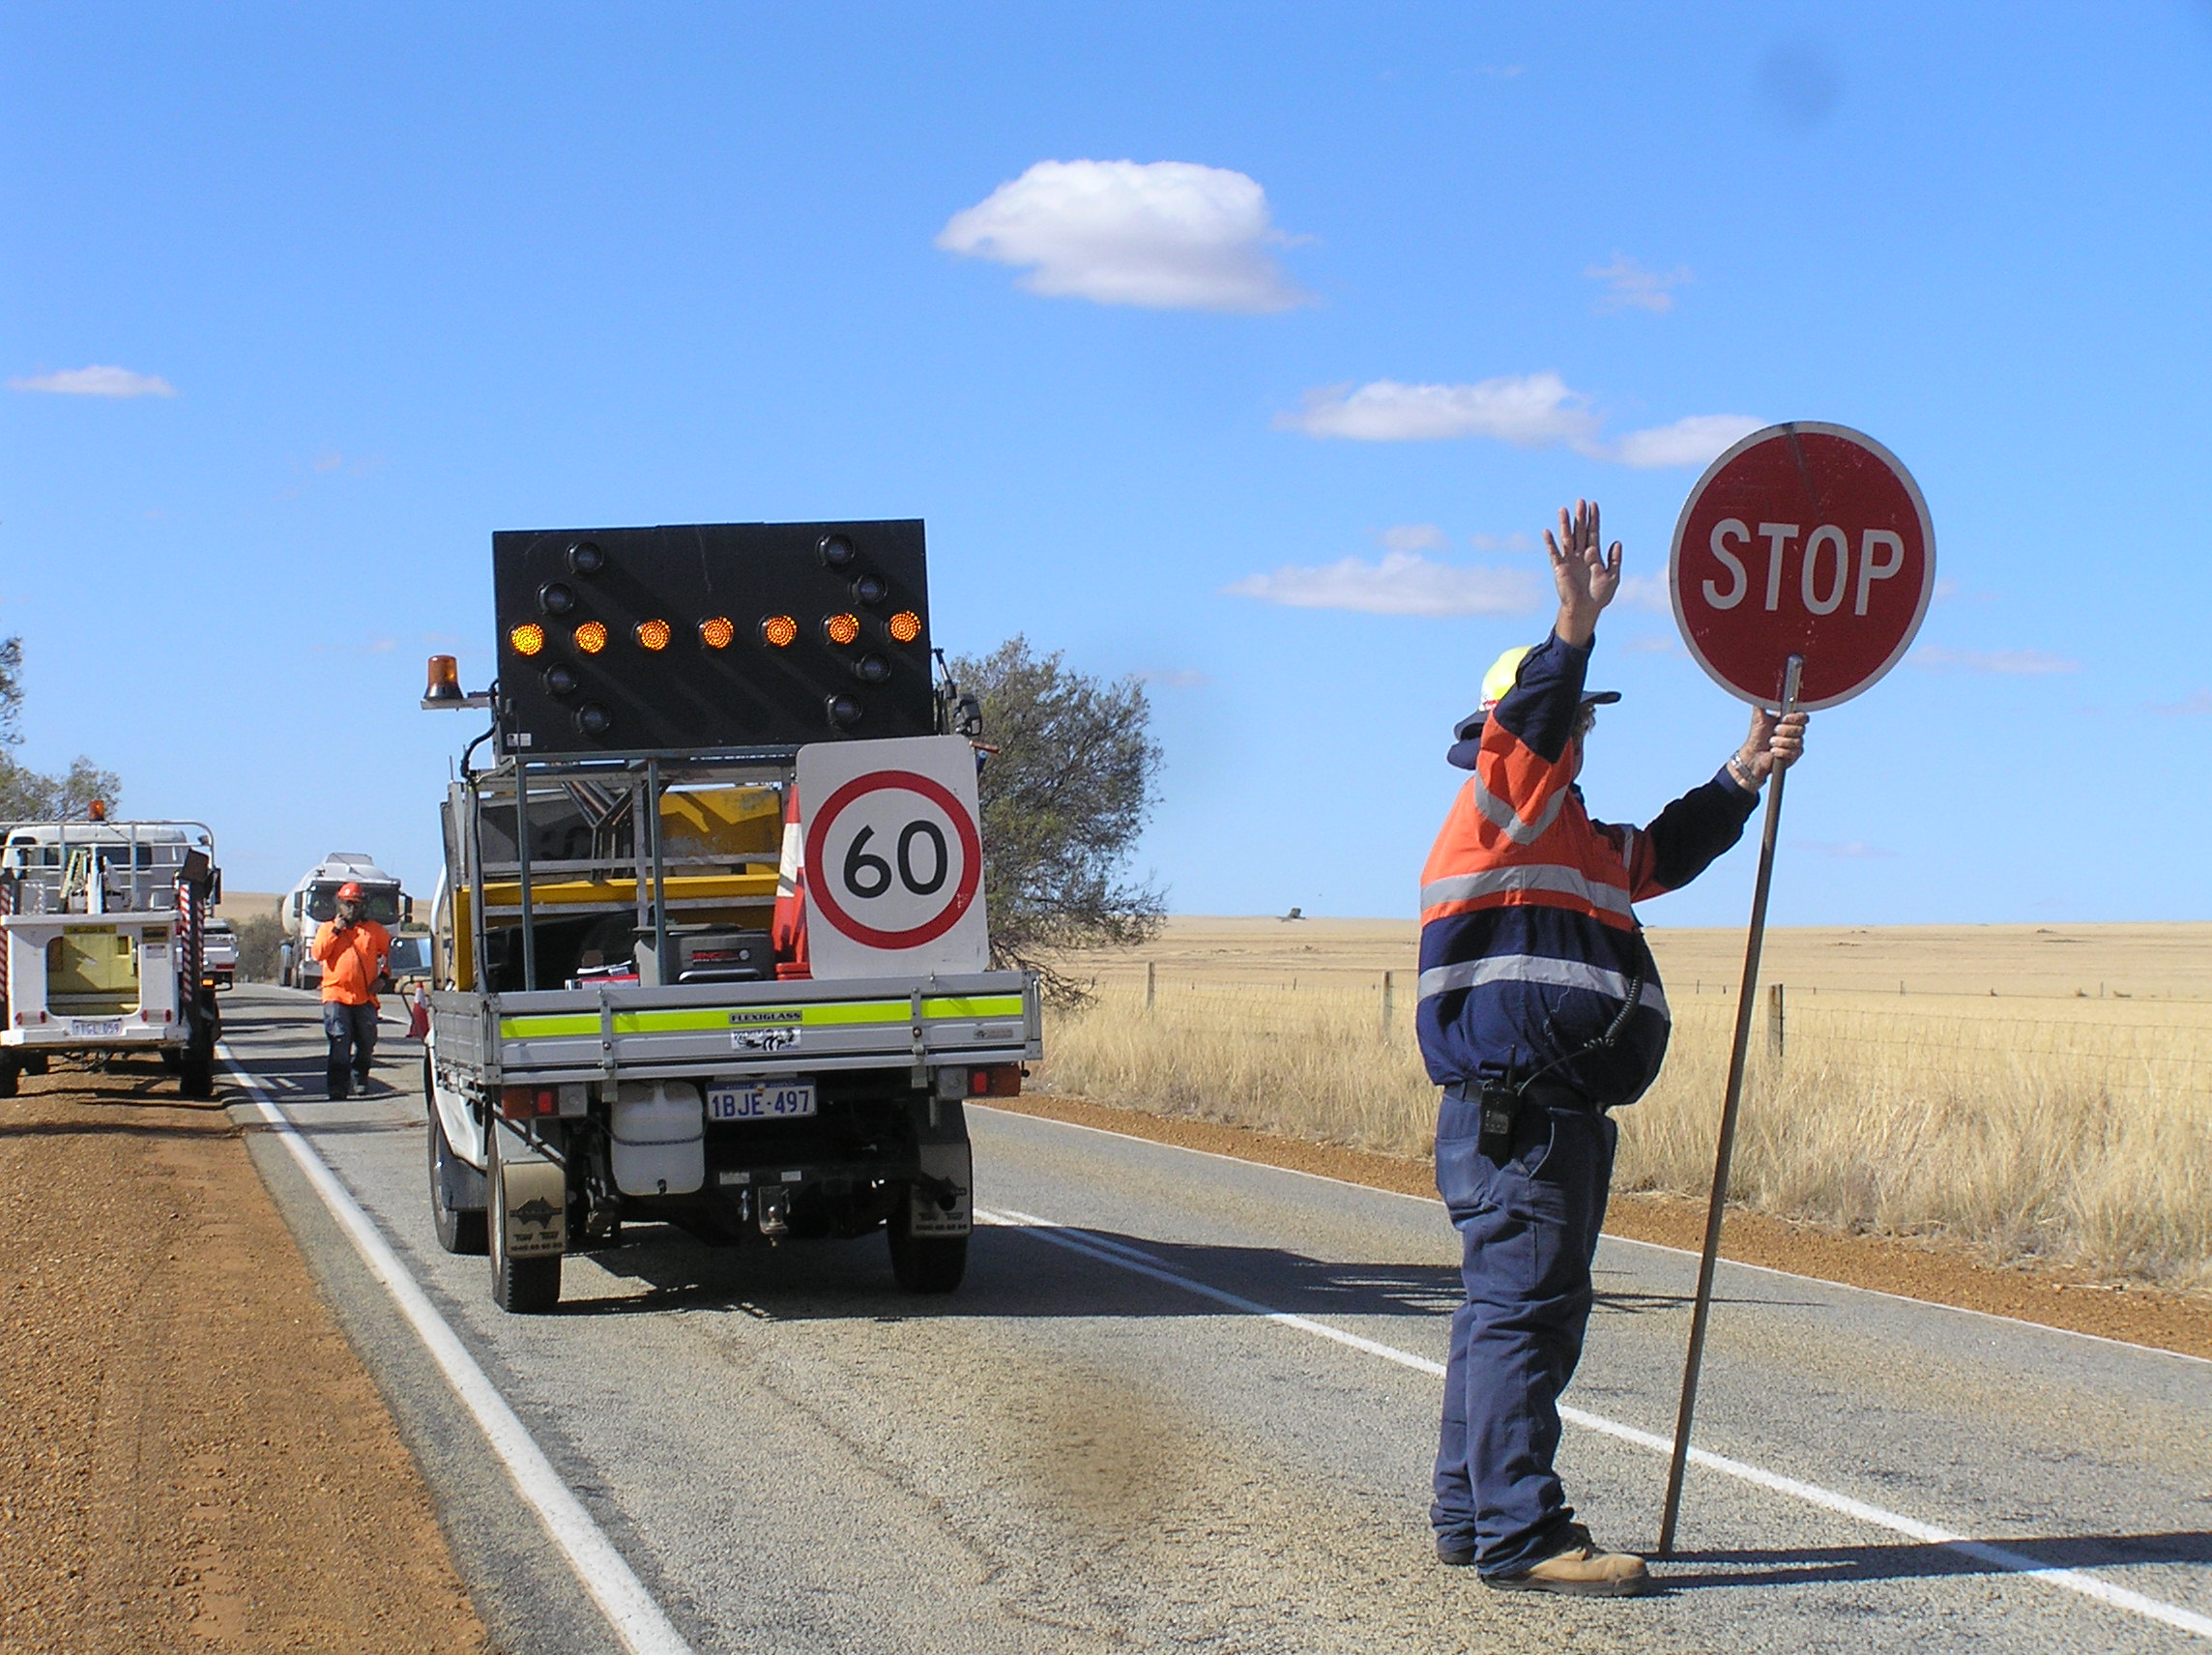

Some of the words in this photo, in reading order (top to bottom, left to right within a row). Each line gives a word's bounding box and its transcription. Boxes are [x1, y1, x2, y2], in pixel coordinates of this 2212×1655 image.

[1702, 517, 1906, 617] STOP
[843, 819, 948, 899] 60
[731, 1012, 801, 1022] FLEXIGLASS
